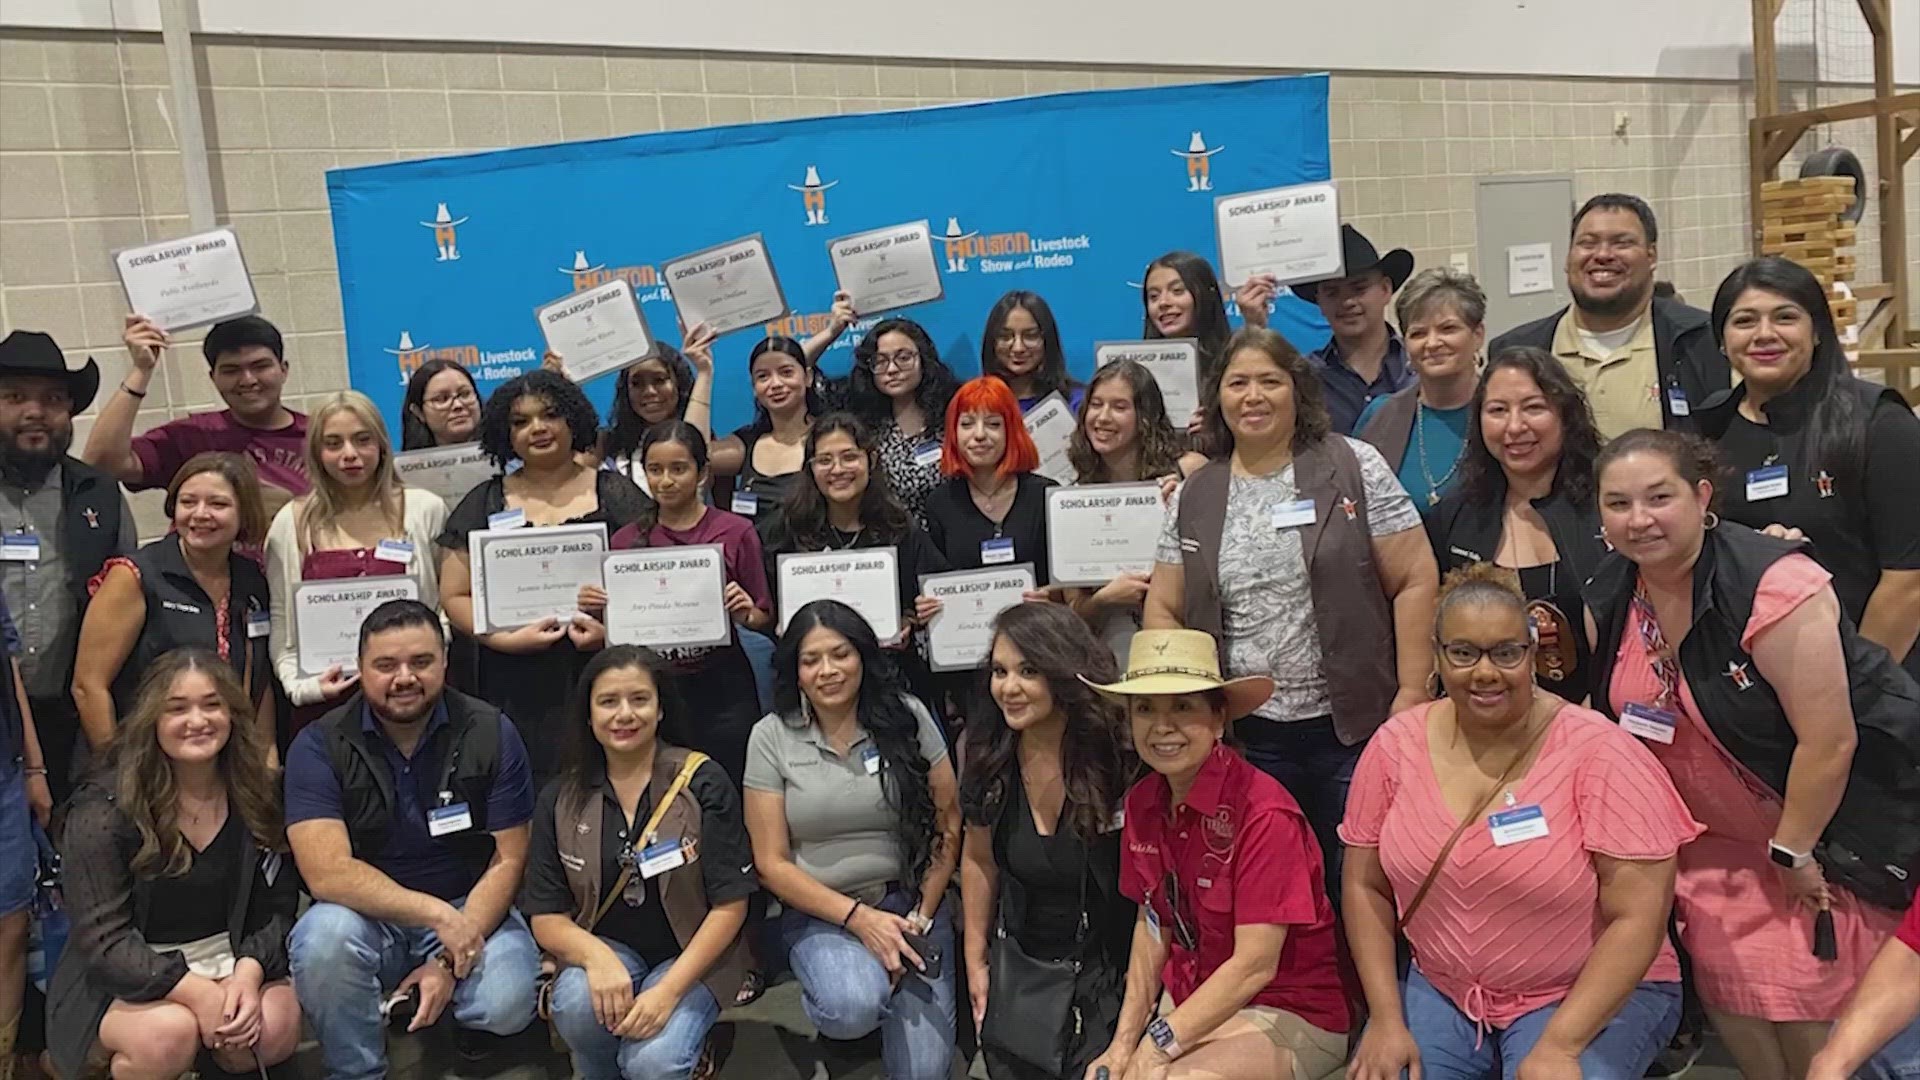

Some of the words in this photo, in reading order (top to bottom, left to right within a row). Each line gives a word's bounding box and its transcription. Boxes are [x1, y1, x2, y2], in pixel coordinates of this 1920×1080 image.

[1228, 199, 1291, 217] SCHOLARSHIP
[1294, 193, 1326, 206] AWARD
[839, 239, 892, 258] SCHOLARSHIP
[894, 232, 920, 245] AWARD
[1031, 234, 1090, 252] Livestock
[129, 246, 193, 268] SCHOLARSHIP
[195, 239, 226, 253] AWARD
[980, 259, 1013, 273] Show
[1014, 255, 1033, 270] and
[1034, 253, 1074, 268] Rodeo
[480, 347, 537, 365] Livestock
[484, 366, 522, 381] Rodeo
[1060, 497, 1121, 510] SCHOLARSHIP
[1124, 496, 1157, 506] AWARD
[495, 545, 558, 559] SCHOLARSHIP
[561, 542, 593, 554] AWARD
[614, 560, 676, 574] SCHOLARSHIP
[679, 558, 711, 569] AWARD
[791, 563, 851, 576] SCHOLARSHIP
[855, 560, 885, 571] AWARD
[933, 582, 991, 596] SCHOLARSHIP
[994, 579, 1024, 590] AWARD
[306, 591, 372, 605] SCHOLARSHIP
[376, 589, 408, 599] AWARD
